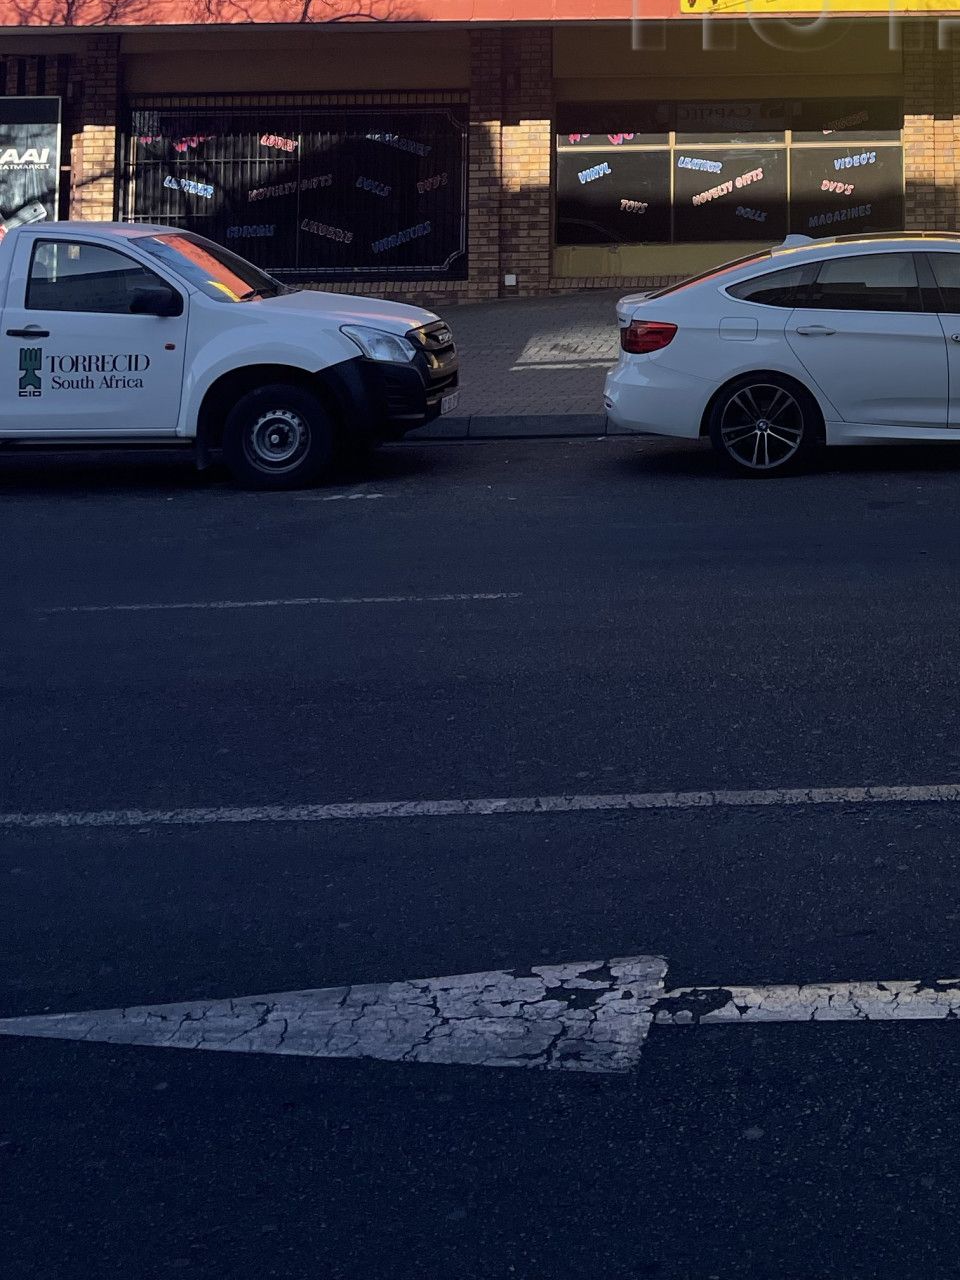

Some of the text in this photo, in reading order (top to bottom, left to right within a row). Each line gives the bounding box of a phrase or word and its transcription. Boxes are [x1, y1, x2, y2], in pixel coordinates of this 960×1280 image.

[0, 148, 50, 164] AAI
[577, 161, 612, 185] VINYL
[692, 167, 764, 206] NOVELTY GIFTS
[619, 198, 649, 214] TOYS
[808, 204, 872, 228] MAGAZINES
[46, 353, 151, 373] TORRECID
[51, 374, 144, 390] South Africa
